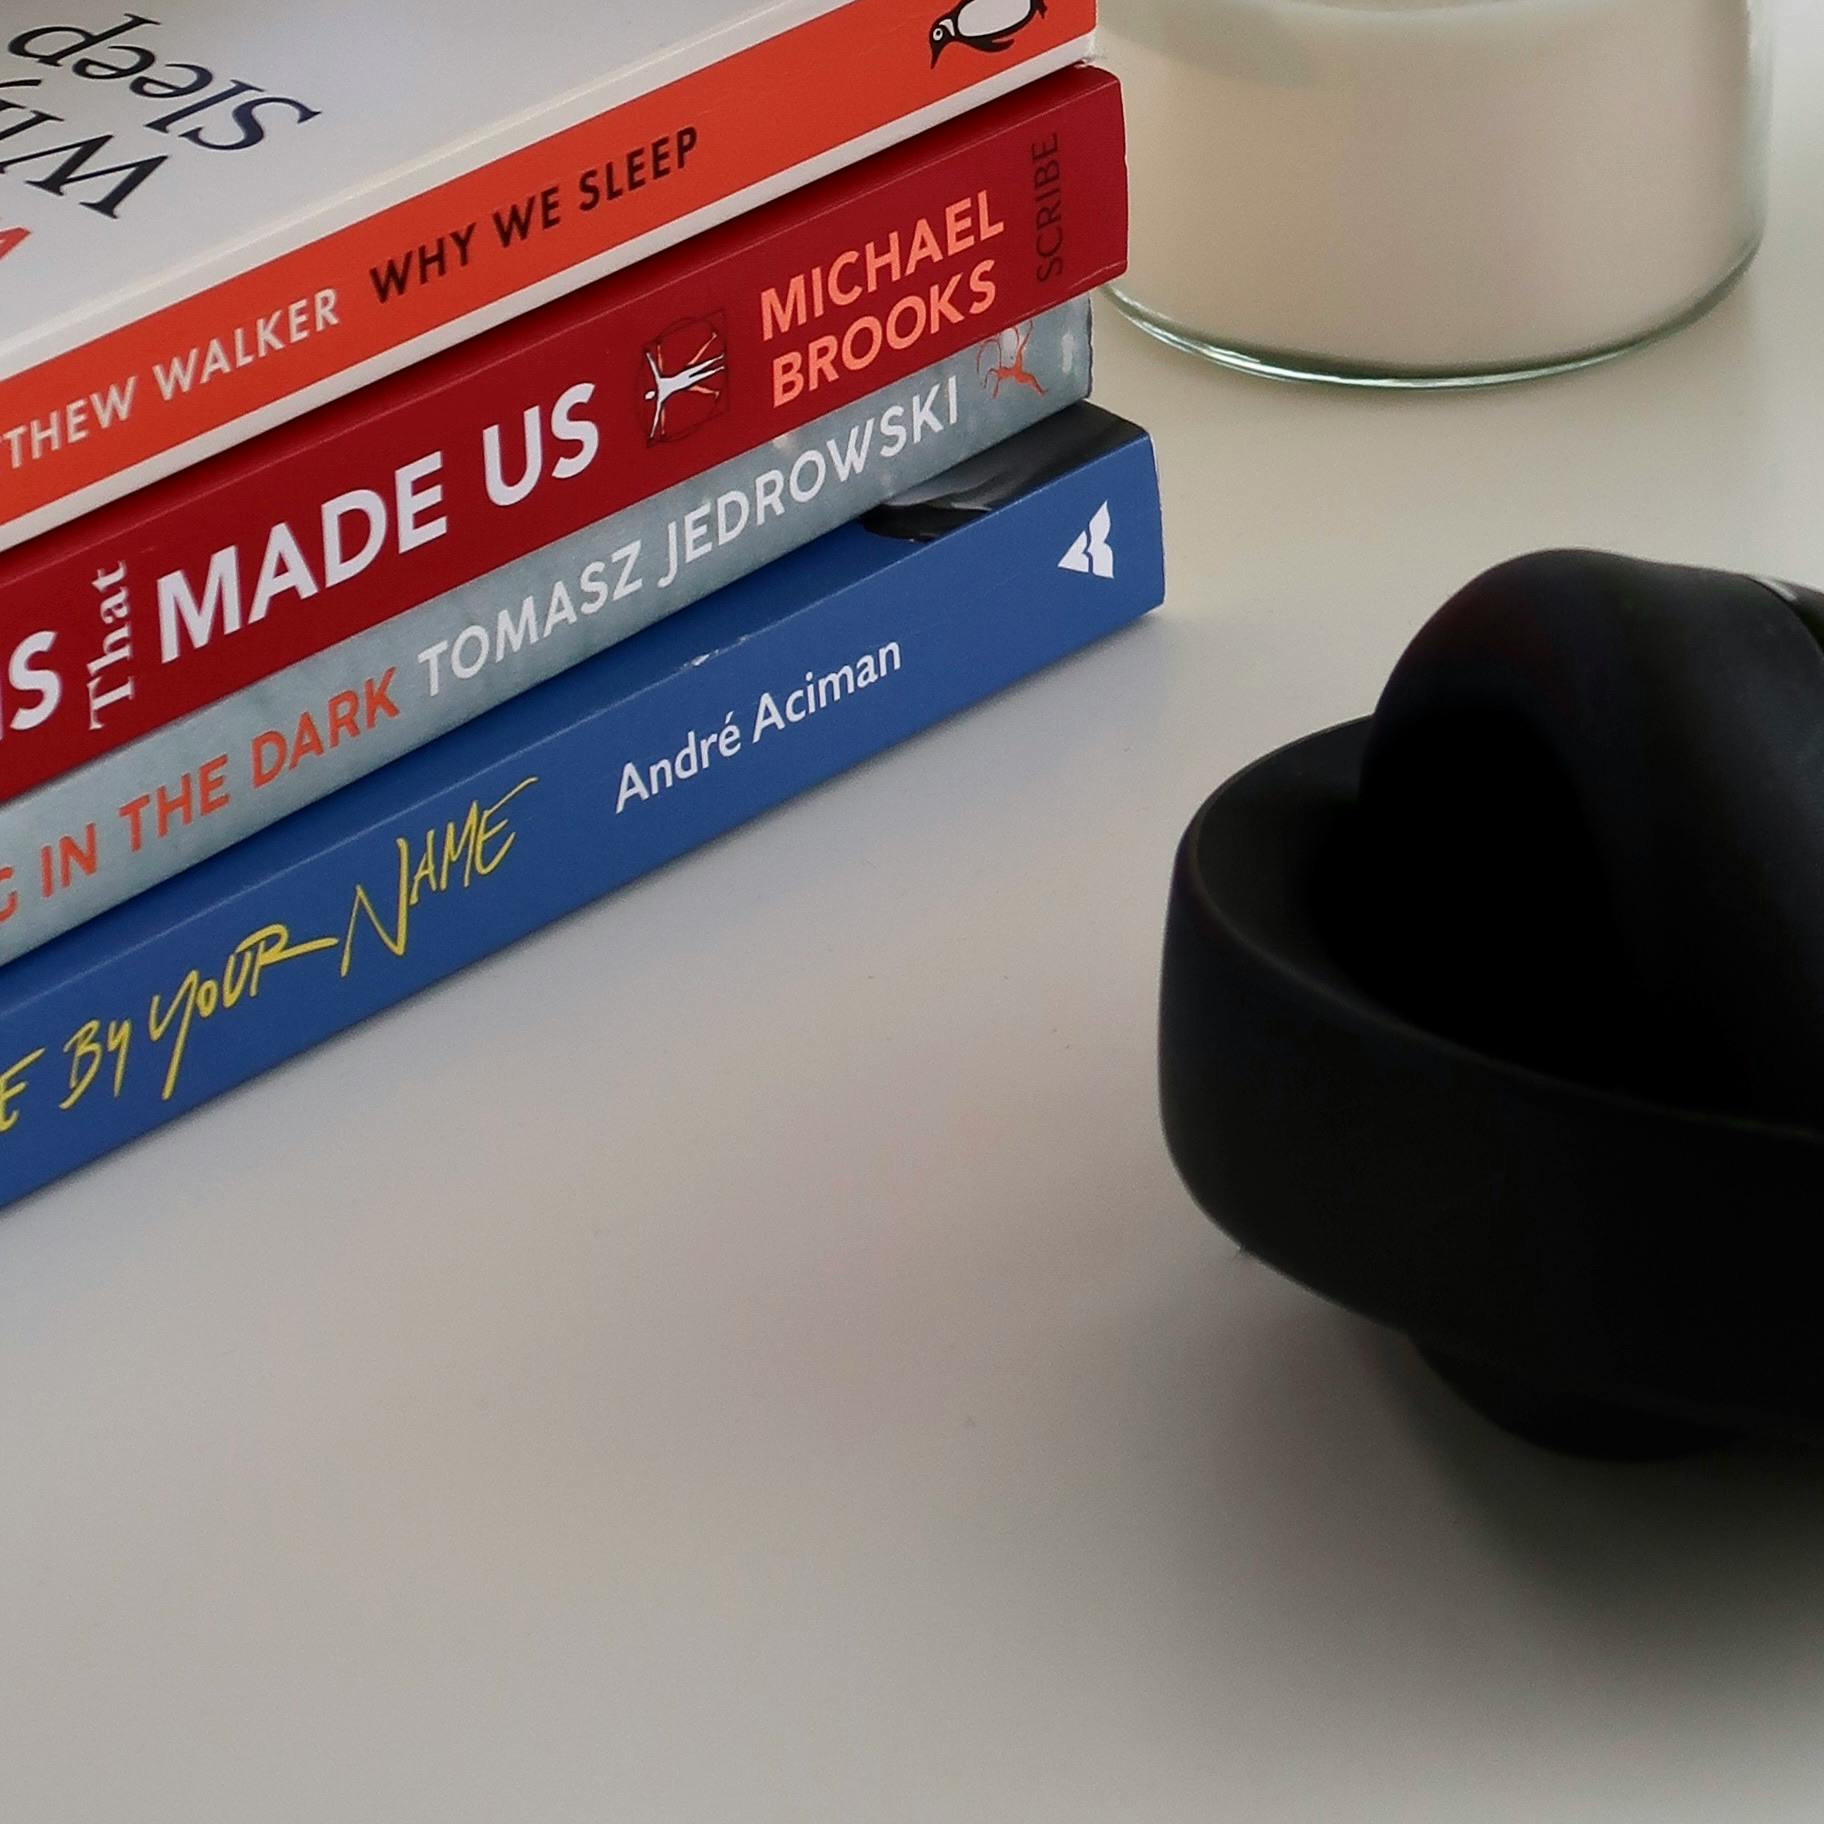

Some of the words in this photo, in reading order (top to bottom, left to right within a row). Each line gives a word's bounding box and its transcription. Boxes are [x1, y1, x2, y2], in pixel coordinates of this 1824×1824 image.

[8, 13, 322, 150] Sleep
[1, 376, 137, 469] THEW
[152, 288, 340, 401] WALKER
[369, 222, 477, 304] WHY
[493, 186, 560, 248] WE
[578, 126, 697, 212] SLEEP
[760, 190, 1004, 341] MICHAEL
[1030, 131, 1063, 283] SCRIBE
[772, 259, 996, 408] BROOKS
[0, 630, 62, 740] S
[86, 560, 136, 730] That
[157, 450, 447, 664] MADE
[482, 383, 599, 507] US
[40, 822, 97, 898] IN
[118, 754, 231, 852] THE
[250, 666, 400, 789] DARK
[417, 541, 643, 698] TOMASZ
[658, 375, 958, 589] JEDROWSKI
[340, 776, 538, 978] NAME
[615, 711, 742, 815] André
[752, 641, 901, 744] Aciman
